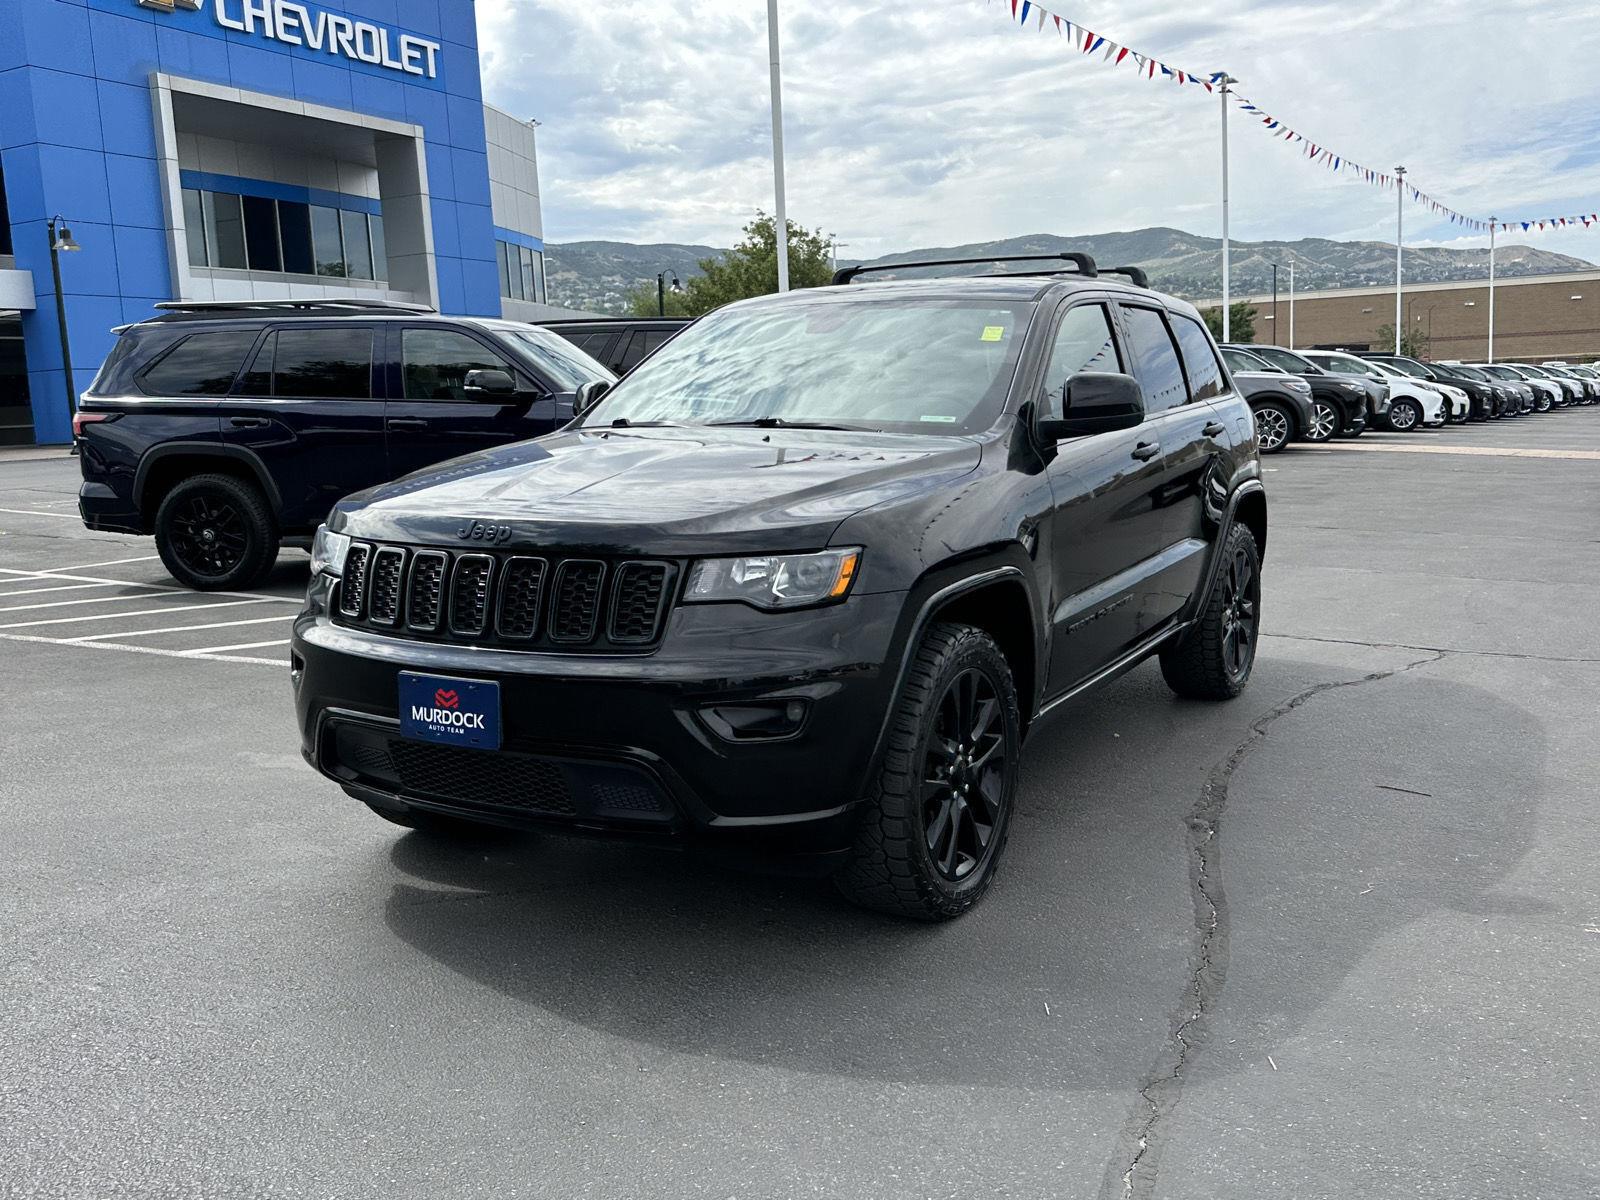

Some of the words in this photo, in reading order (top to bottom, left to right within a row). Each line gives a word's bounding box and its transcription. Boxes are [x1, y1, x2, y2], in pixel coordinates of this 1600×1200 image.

[215, 0, 440, 78] CHEVROLET
[457, 520, 511, 544] Jeep
[412, 705, 484, 729] MURDOCK
[428, 724, 445, 732] AUTO
[447, 726, 464, 735] TEAM
